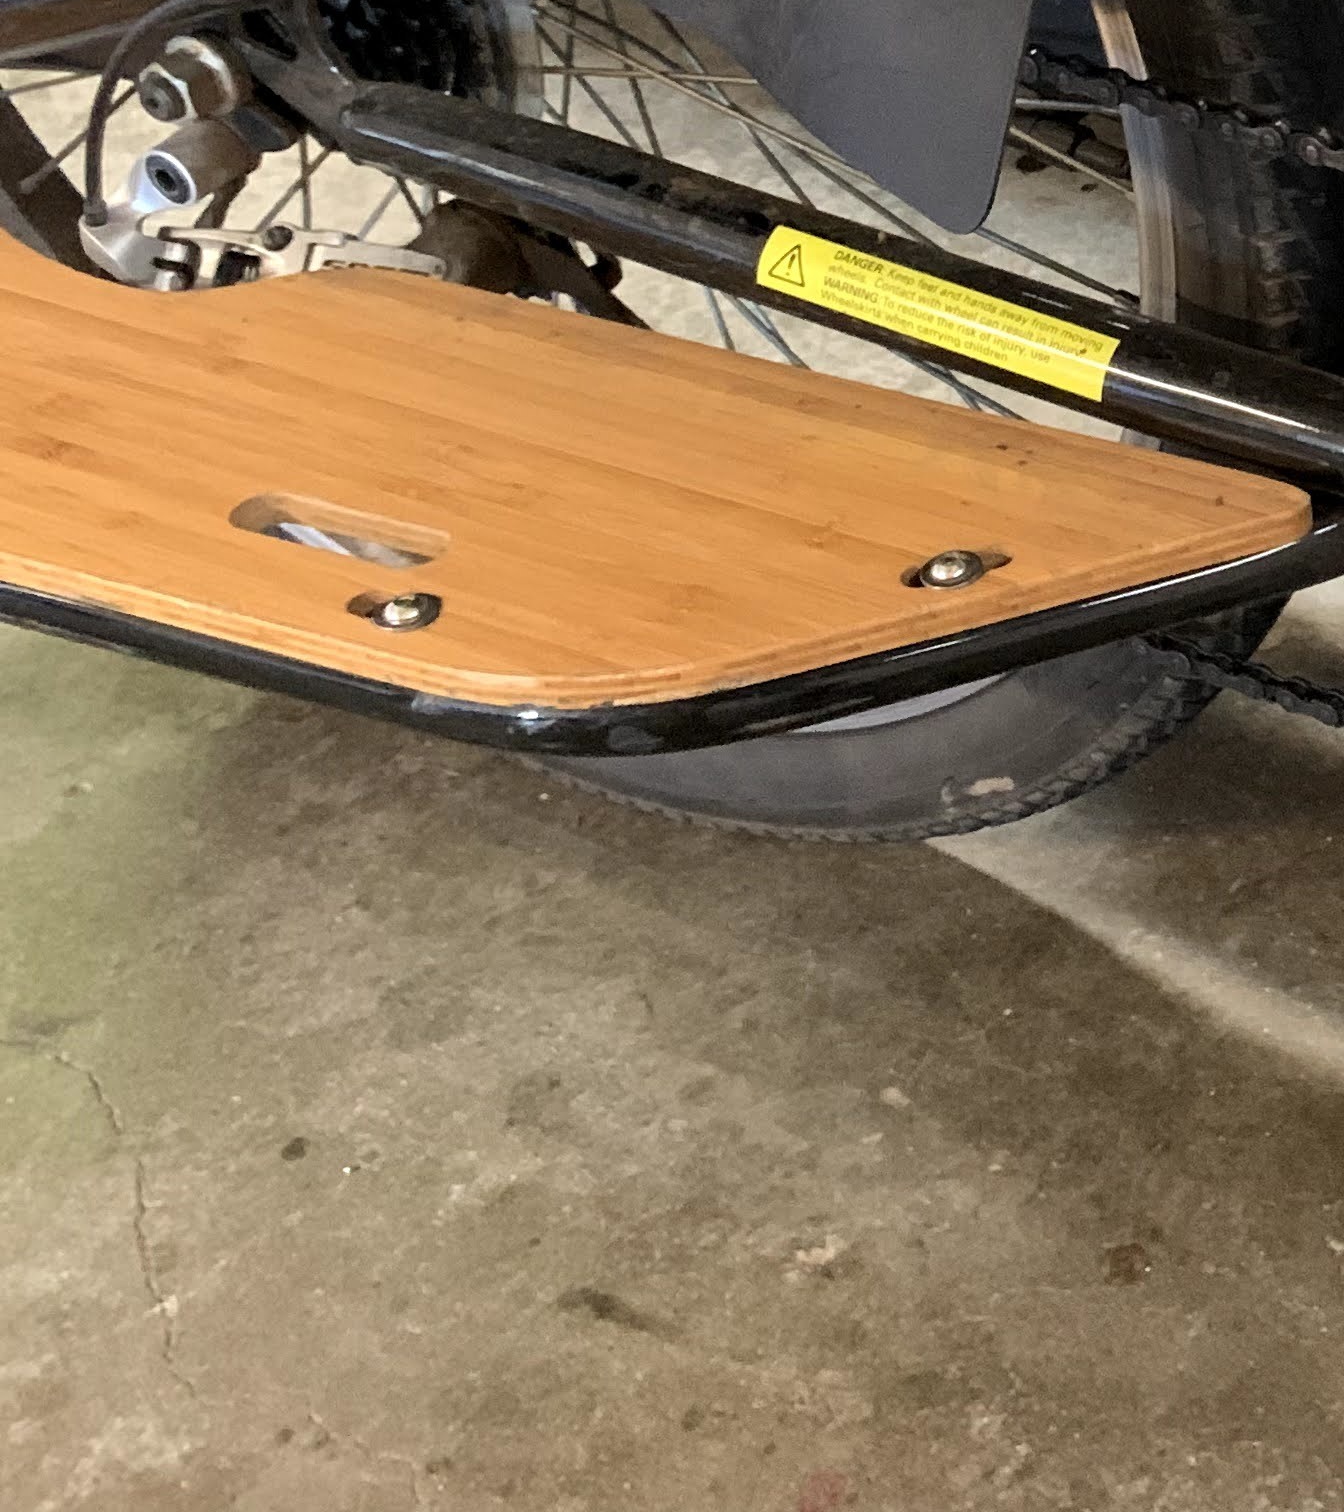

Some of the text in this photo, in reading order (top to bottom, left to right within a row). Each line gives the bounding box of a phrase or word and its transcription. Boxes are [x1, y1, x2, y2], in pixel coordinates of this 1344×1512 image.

[875, 278, 914, 298] Contact
[918, 294, 940, 307] with
[945, 303, 976, 319] wheel
[980, 317, 998, 327] can
[1002, 323, 1032, 338] result
[883, 297, 894, 307] To
[898, 304, 933, 322] reduce
[936, 317, 953, 328] the
[957, 324, 975, 336] risk
[979, 332, 989, 341] of
[1031, 351, 1049, 361] use
[885, 312, 913, 327] when
[916, 325, 960, 346] carrying
[888, 270, 914, 284] Keep
[940, 288, 960, 300] and
[964, 295, 996, 312] hands
[999, 308, 1027, 324] away
[1031, 319, 1057, 334] from
[1060, 330, 1102, 351] moving
